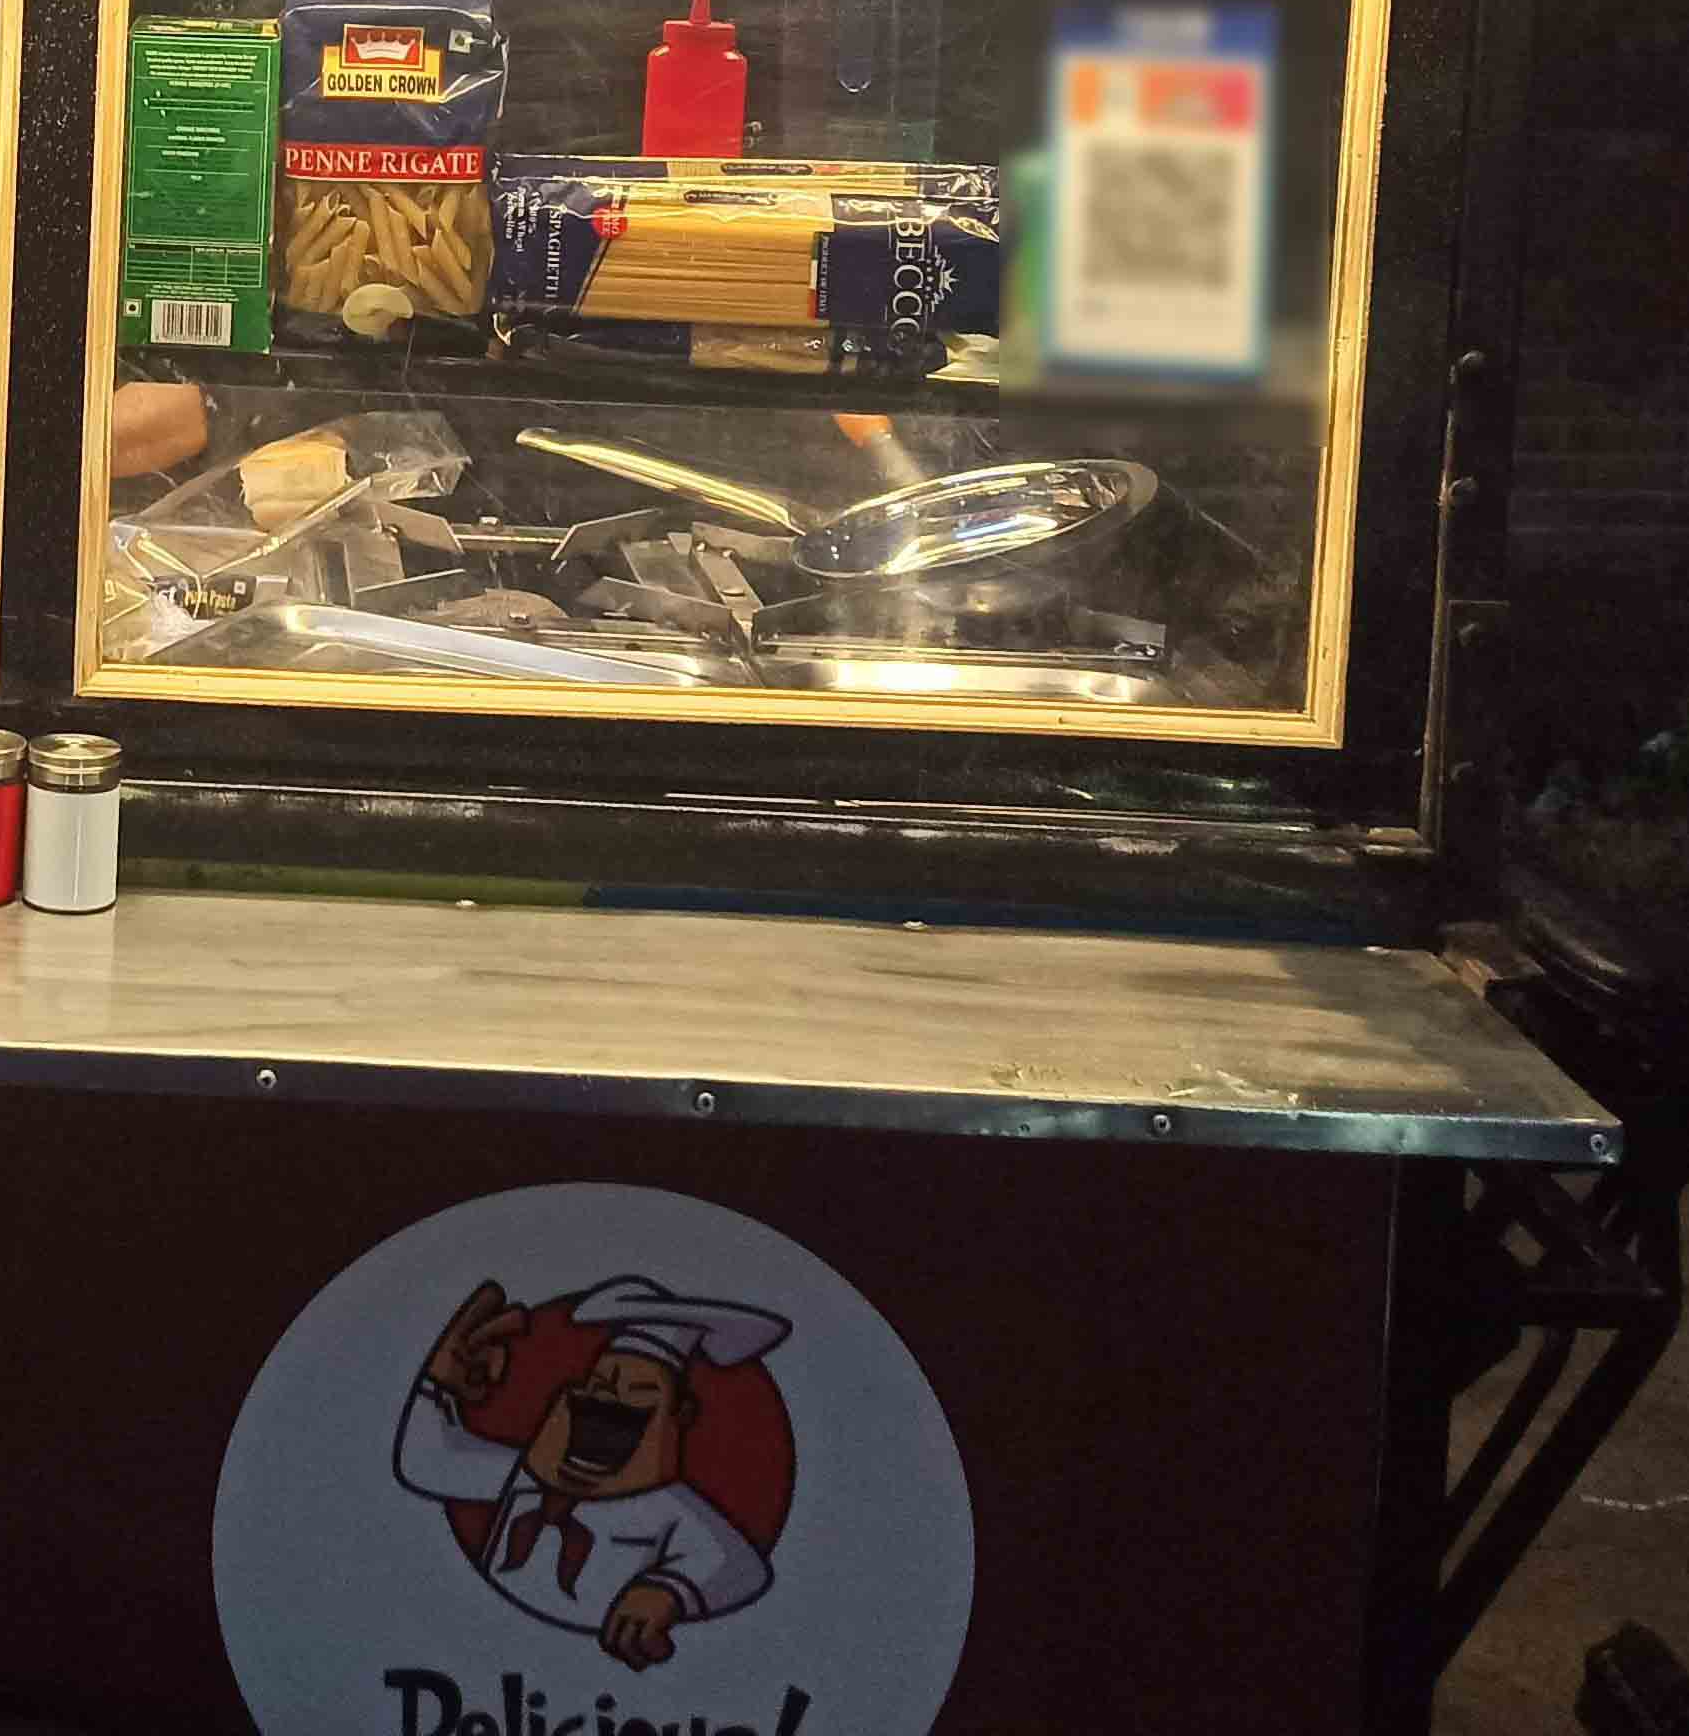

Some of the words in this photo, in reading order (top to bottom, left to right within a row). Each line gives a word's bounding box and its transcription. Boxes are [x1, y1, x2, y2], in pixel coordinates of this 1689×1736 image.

[327, 73, 383, 92] GOLDEN
[388, 75, 437, 96] CROWN
[285, 147, 373, 173] PENNE
[379, 151, 480, 176] RIGATE
[544, 209, 563, 299] SPAGHETTI
